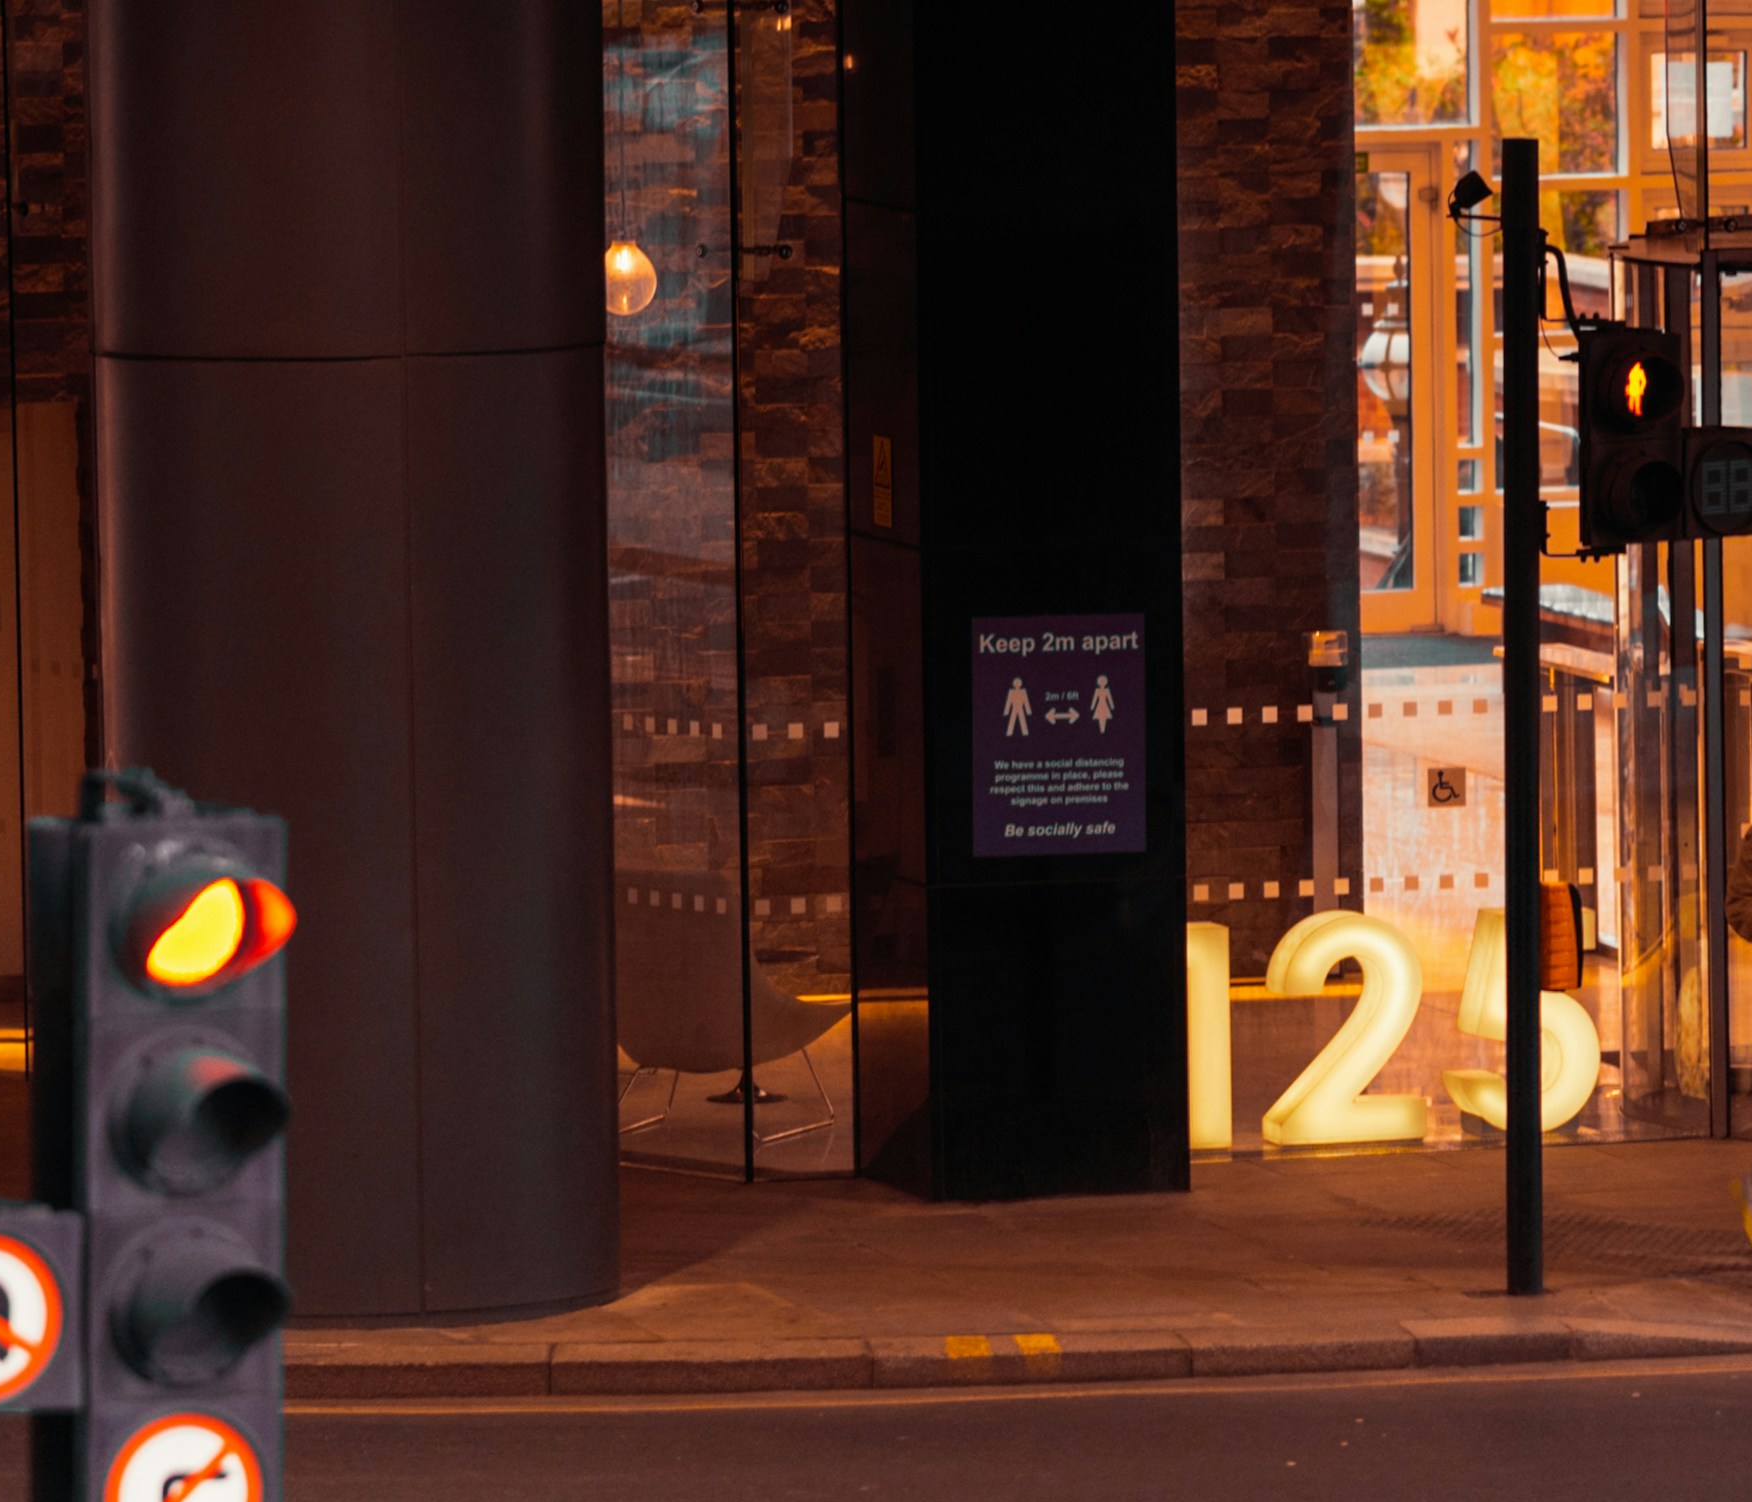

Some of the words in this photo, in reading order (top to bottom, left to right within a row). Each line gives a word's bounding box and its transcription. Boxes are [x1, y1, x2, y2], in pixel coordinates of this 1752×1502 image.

[979, 633, 1036, 657] Keep
[1042, 632, 1076, 652] 2m
[1082, 631, 1139, 656] apart
[1045, 692, 1060, 702] 2m
[994, 760, 1010, 769] We
[1011, 759, 1034, 769] have
[1036, 760, 1044, 769] a
[1045, 758, 1074, 769] social
[1075, 757, 1125, 769] distancing
[995, 772, 1049, 784] programme
[1051, 771, 1061, 780] in
[1093, 770, 1124, 781] please
[990, 784, 1025, 796] respect
[1027, 784, 1045, 793] this
[1047, 783, 1066, 793] and
[1067, 783, 1100, 792] adhere
[1102, 782, 1112, 791] to
[1114, 781, 1129, 791] the
[1011, 795, 1048, 807] signage
[1050, 796, 1063, 805] on
[1065, 794, 1108, 806] premises
[1004, 823, 1024, 837] Be
[1027, 821, 1083, 839] socially
[1085, 820, 1116, 835] safe
[1187, 908, 1601, 1150] 125
